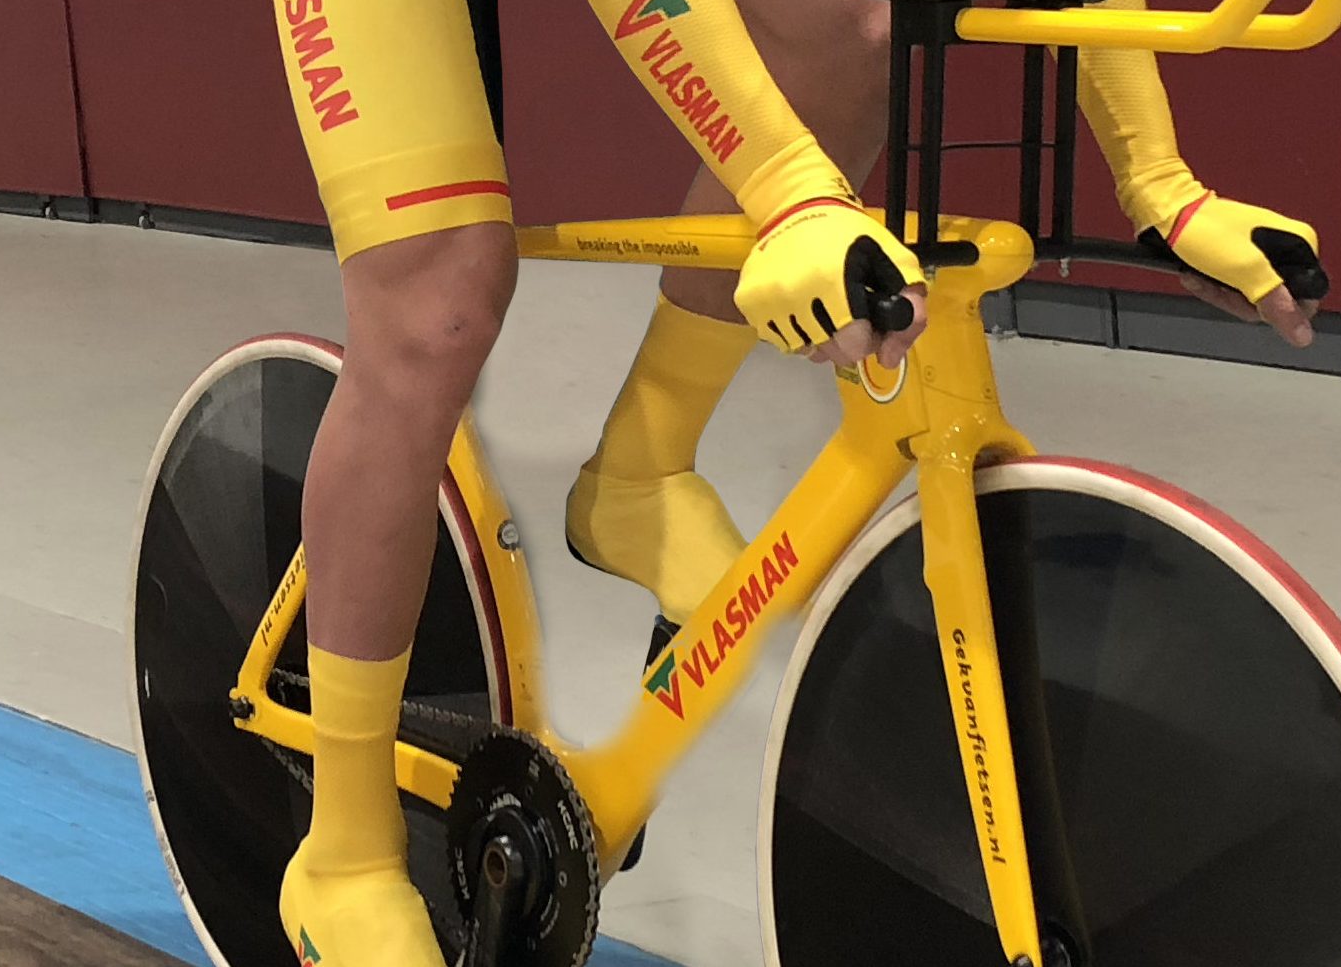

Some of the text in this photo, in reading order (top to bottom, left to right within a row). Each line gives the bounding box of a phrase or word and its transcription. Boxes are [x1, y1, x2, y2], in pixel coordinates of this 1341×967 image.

[640, 28, 744, 164] VLASMAN
[576, 236, 700, 256] breaking the impossible
[681, 530, 799, 689] VLASMAN
